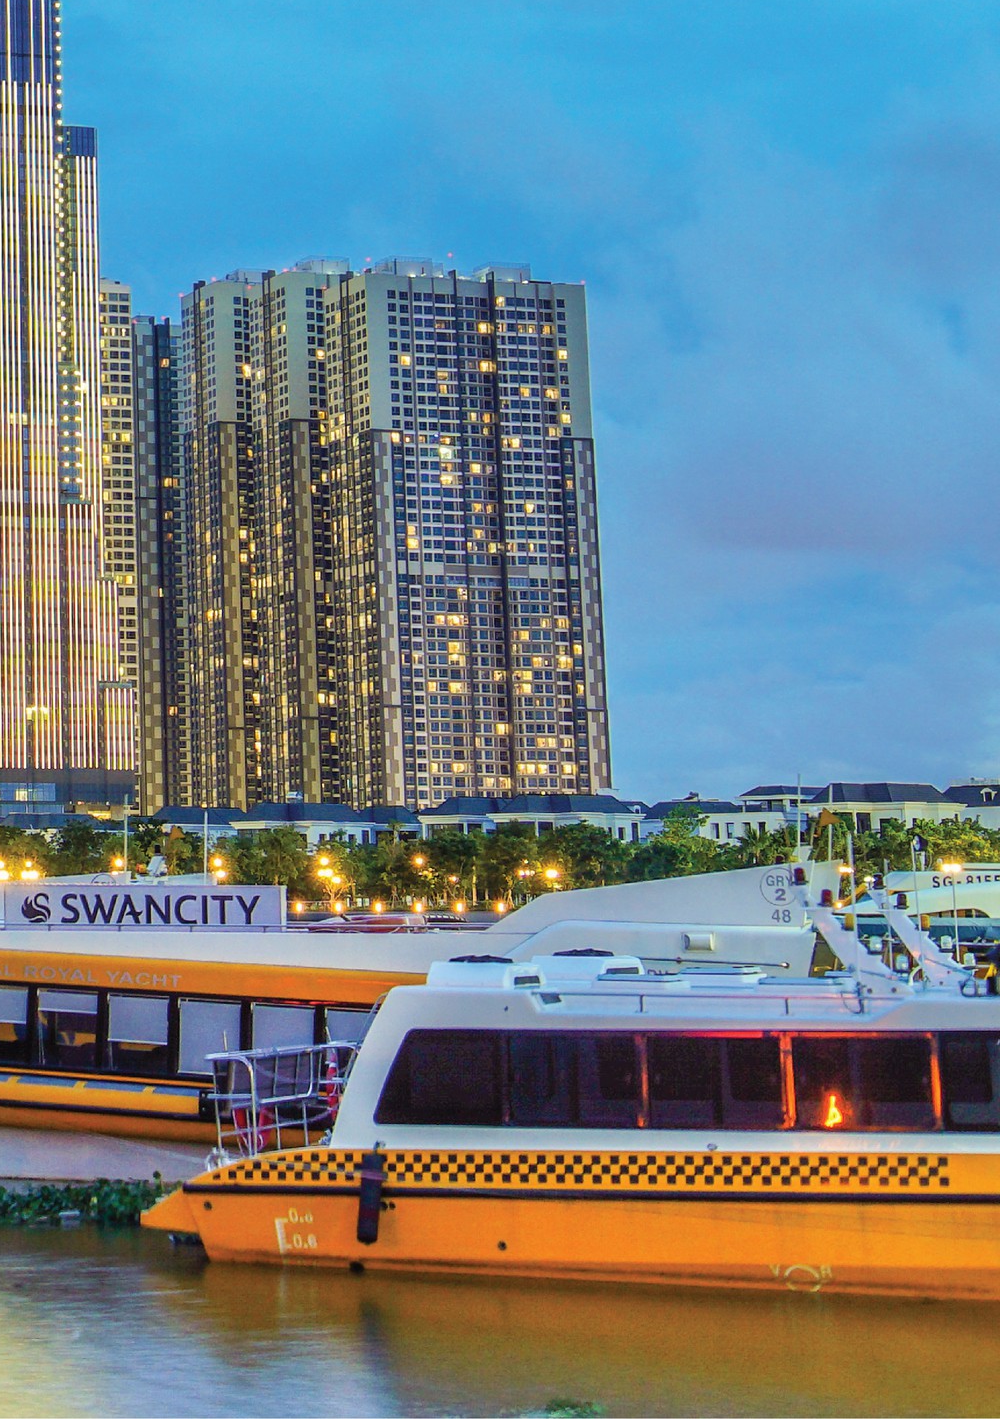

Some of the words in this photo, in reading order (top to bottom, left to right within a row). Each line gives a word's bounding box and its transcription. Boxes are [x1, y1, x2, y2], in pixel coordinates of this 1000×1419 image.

[775, 888, 787, 902] 2
[60, 893, 261, 925] SWANCITY
[771, 908, 792, 924] 48
[23, 965, 98, 983] ROYAL
[106, 970, 182, 988] YACHT
